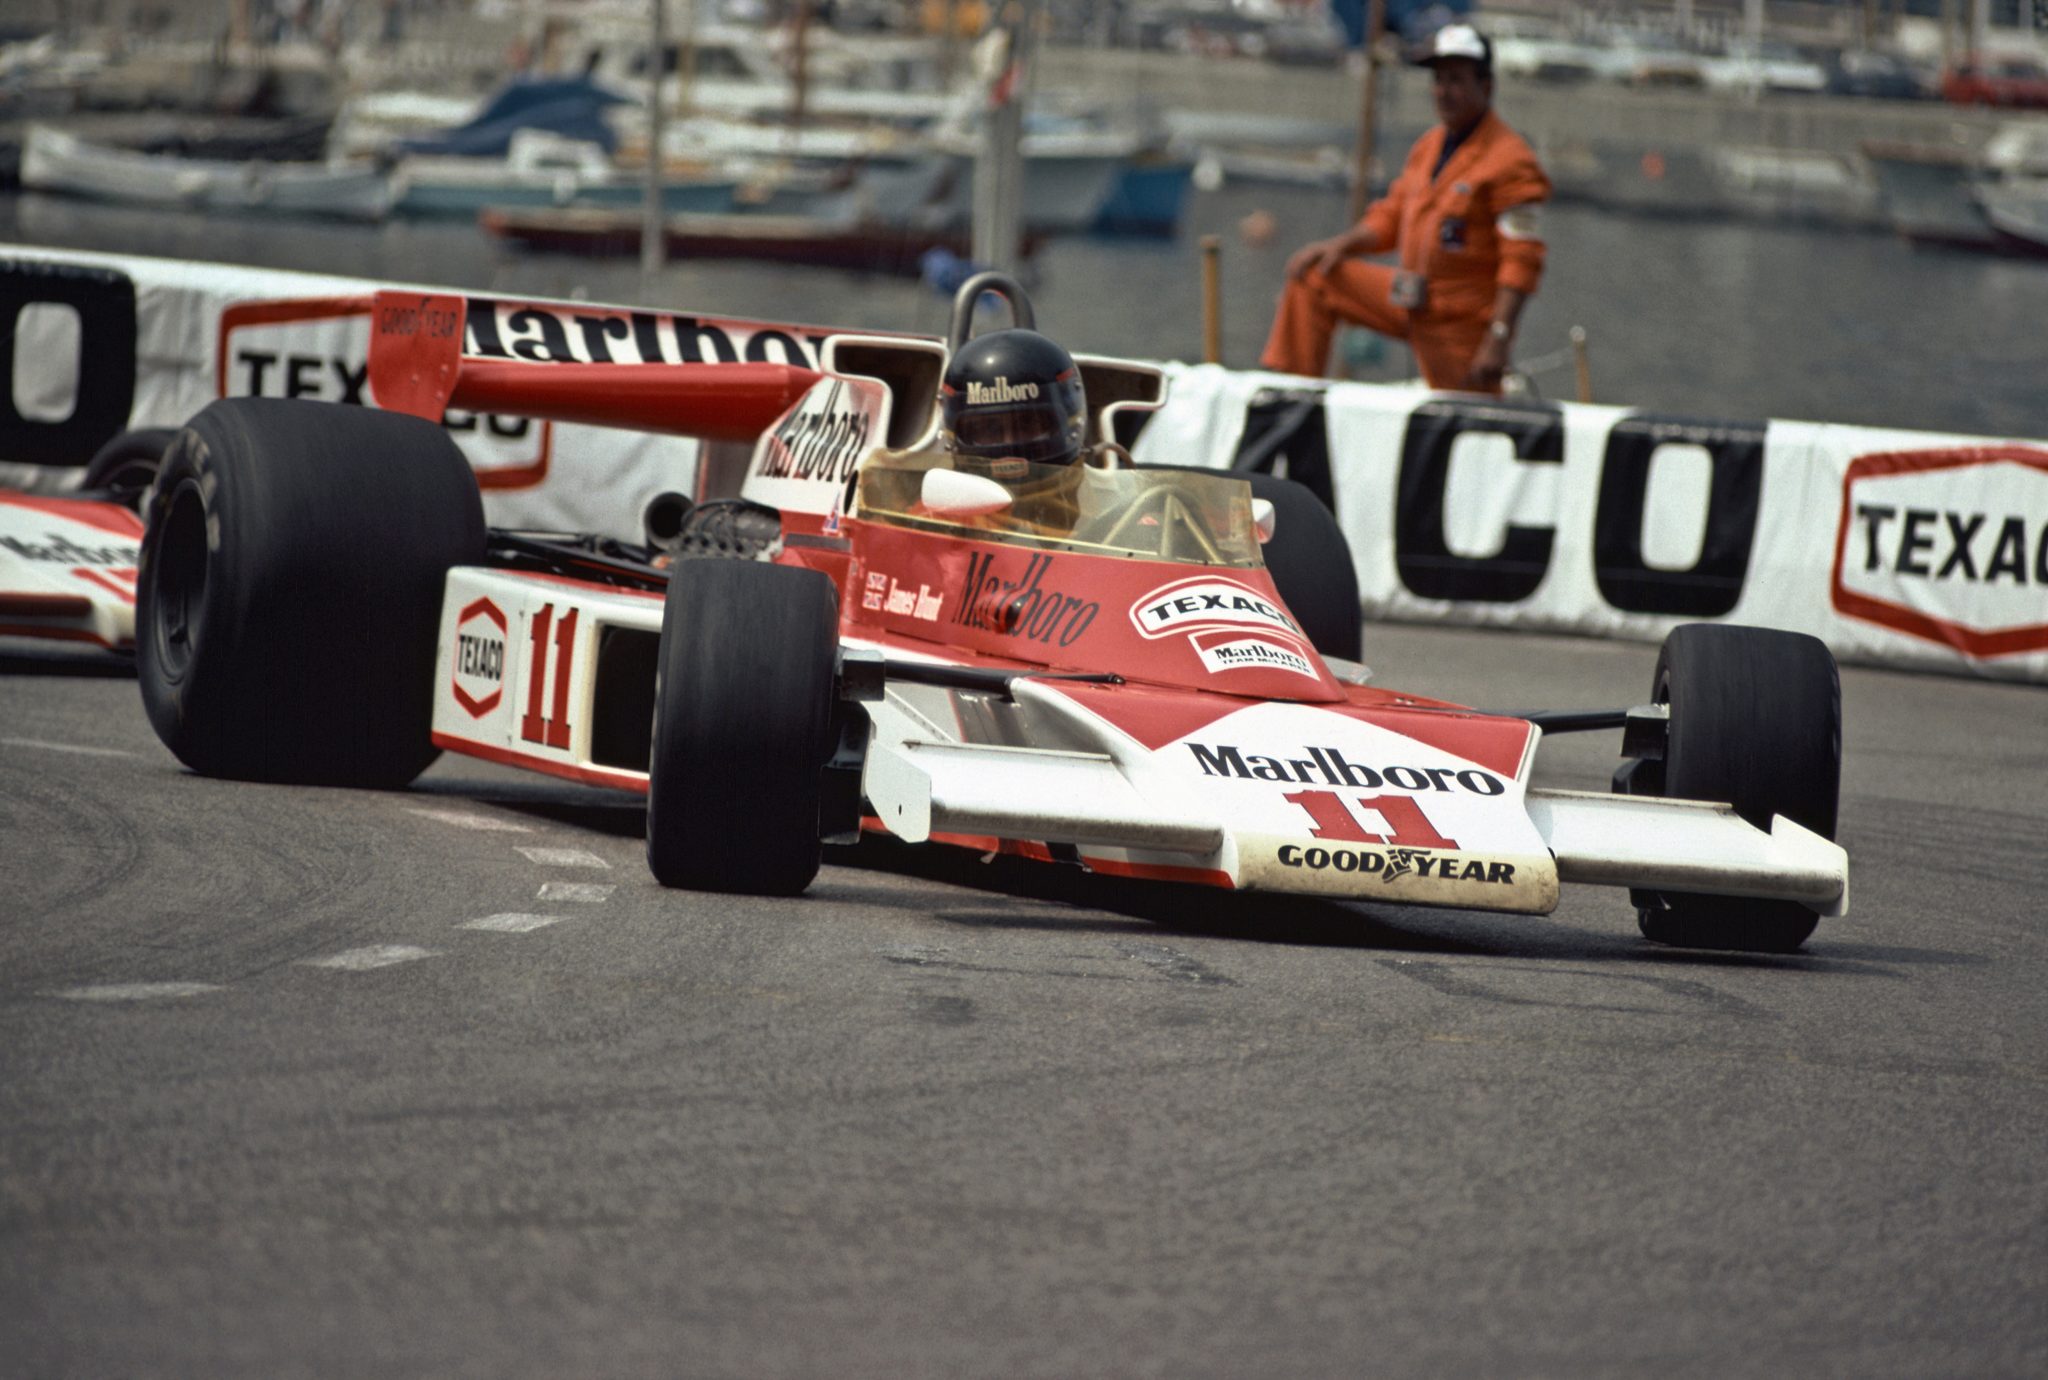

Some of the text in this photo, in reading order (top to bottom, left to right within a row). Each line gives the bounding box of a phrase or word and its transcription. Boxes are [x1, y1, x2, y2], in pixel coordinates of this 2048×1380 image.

[966, 376, 1040, 405] Marlboro
[458, 634, 504, 681] TEXACO
[521, 602, 579, 751] 11
[1214, 645, 1307, 667] Marlboro
[1184, 742, 1505, 796] Marlboro
[1282, 789, 1461, 850] 11
[1277, 844, 1516, 884] GOOD YEAR
